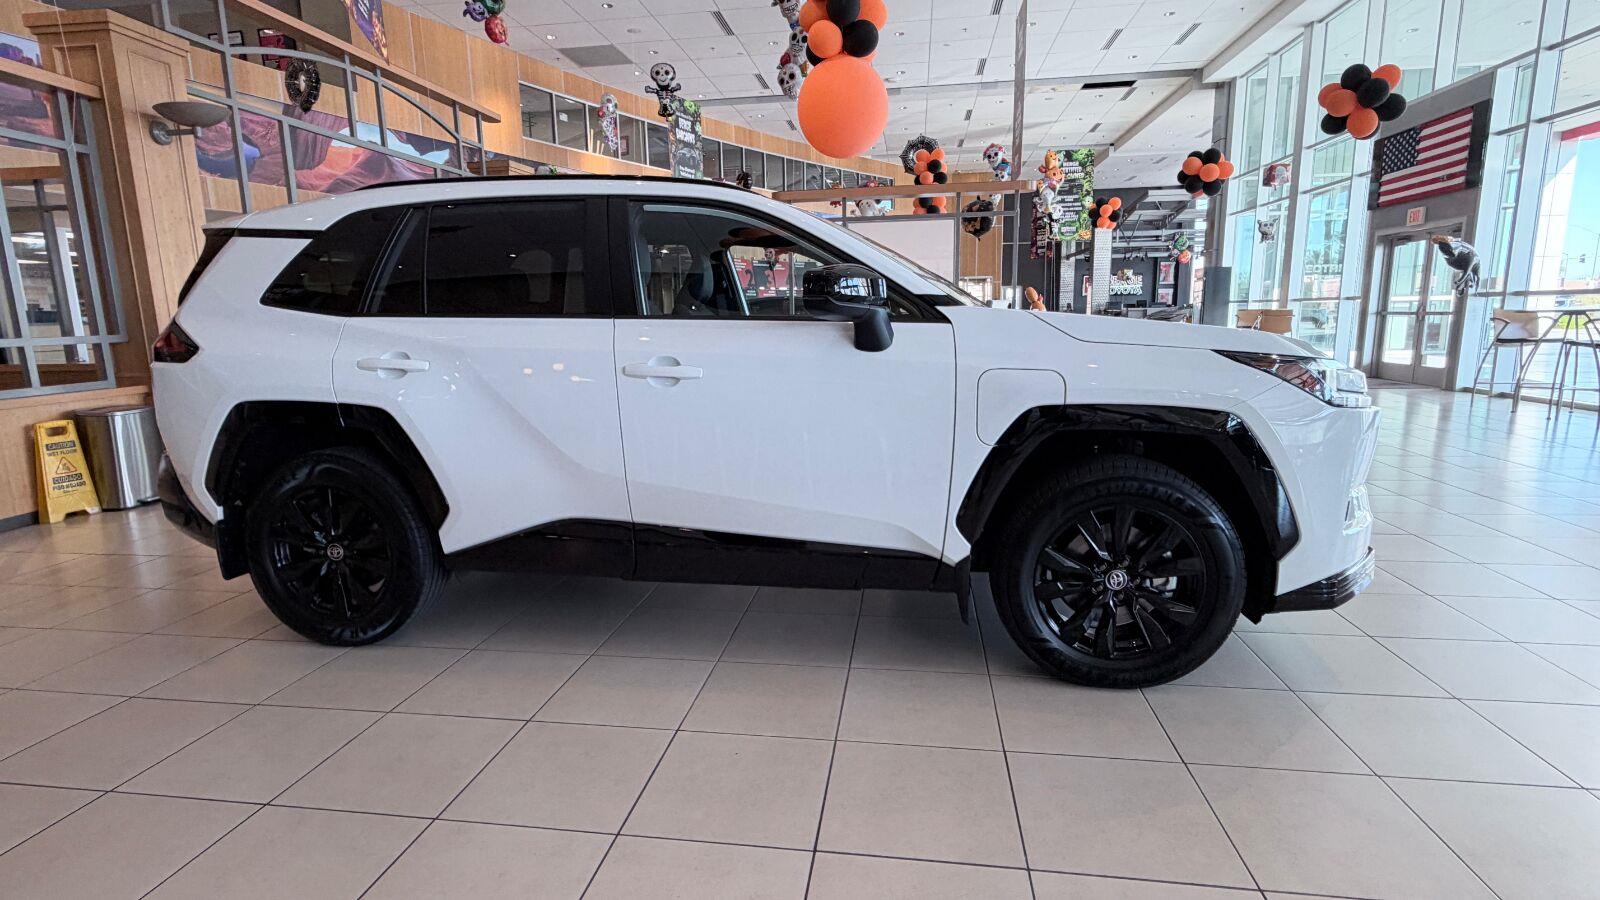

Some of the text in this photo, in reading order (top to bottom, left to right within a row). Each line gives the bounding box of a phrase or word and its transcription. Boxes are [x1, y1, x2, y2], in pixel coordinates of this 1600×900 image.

[1409, 209, 1422, 223] EXIT
[1110, 285, 1142, 295] OYOTA
[47, 442, 75, 450] CAUTION
[60, 448, 77, 456] FLOOR
[53, 473, 82, 484] CUIDADO
